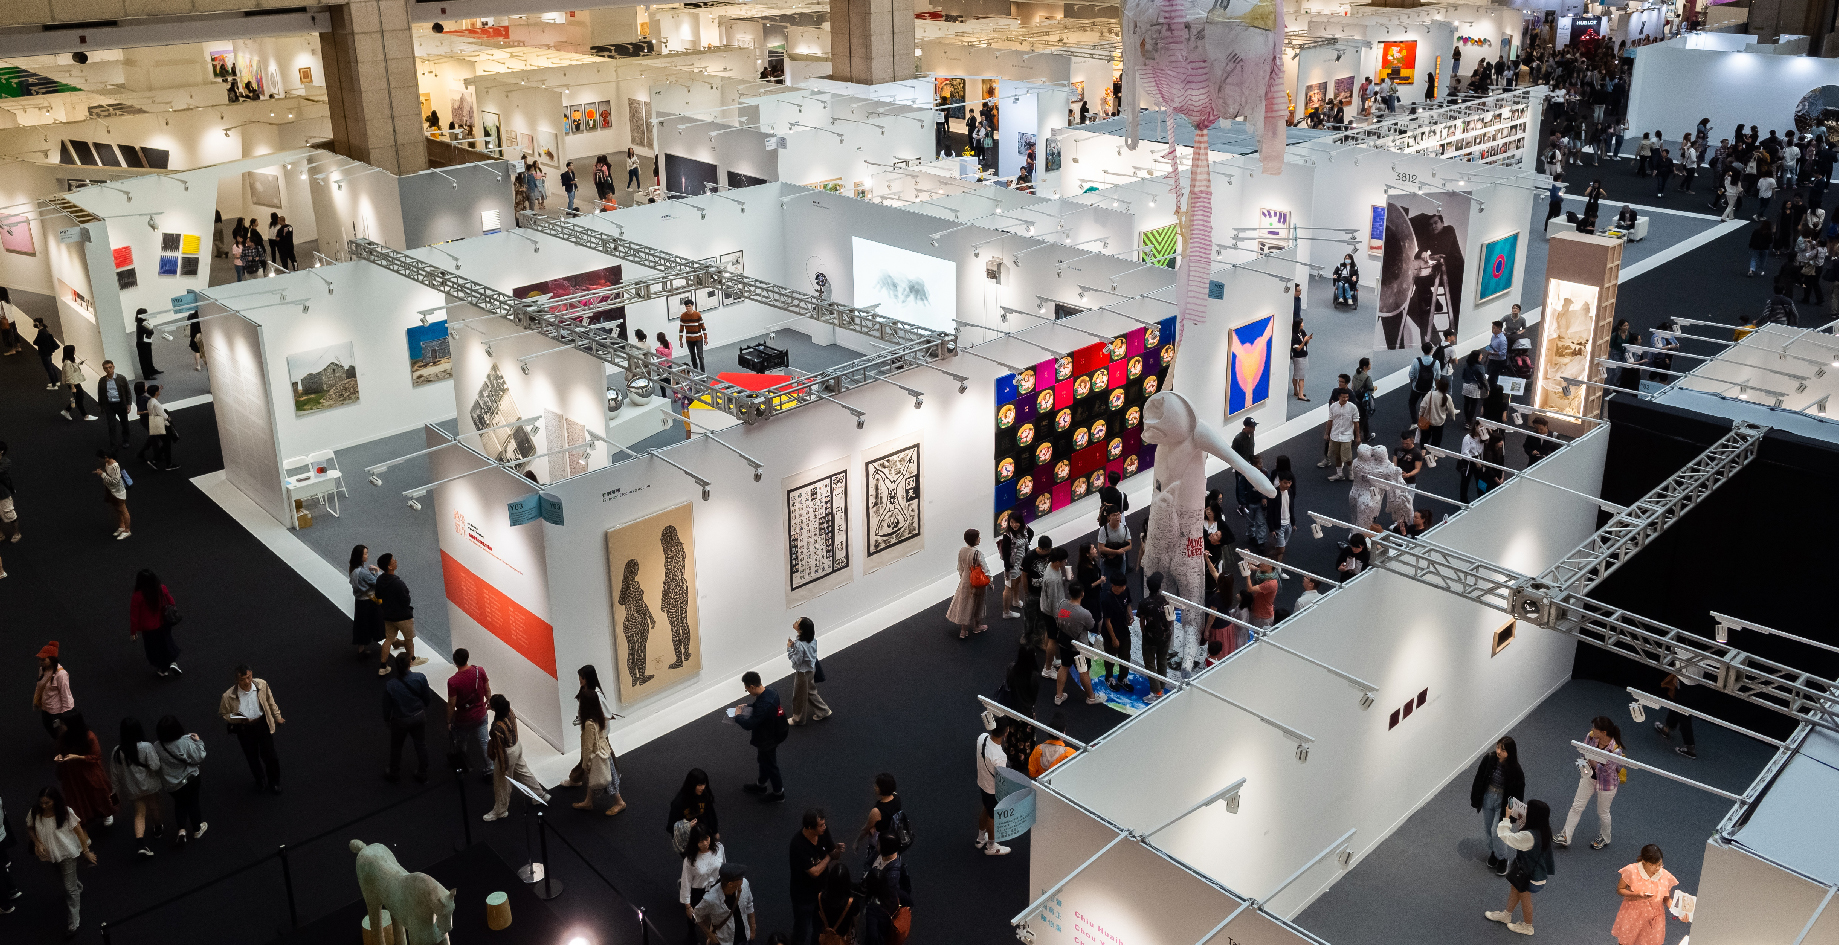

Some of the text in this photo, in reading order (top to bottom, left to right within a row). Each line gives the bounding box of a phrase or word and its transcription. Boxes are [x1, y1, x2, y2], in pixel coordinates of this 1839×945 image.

[1395, 171, 1418, 184] 3812
[509, 503, 524, 511] Y03
[996, 807, 1015, 820] Y02
[1074, 911, 1095, 928] Chiu
[1074, 923, 1096, 942] Chou
